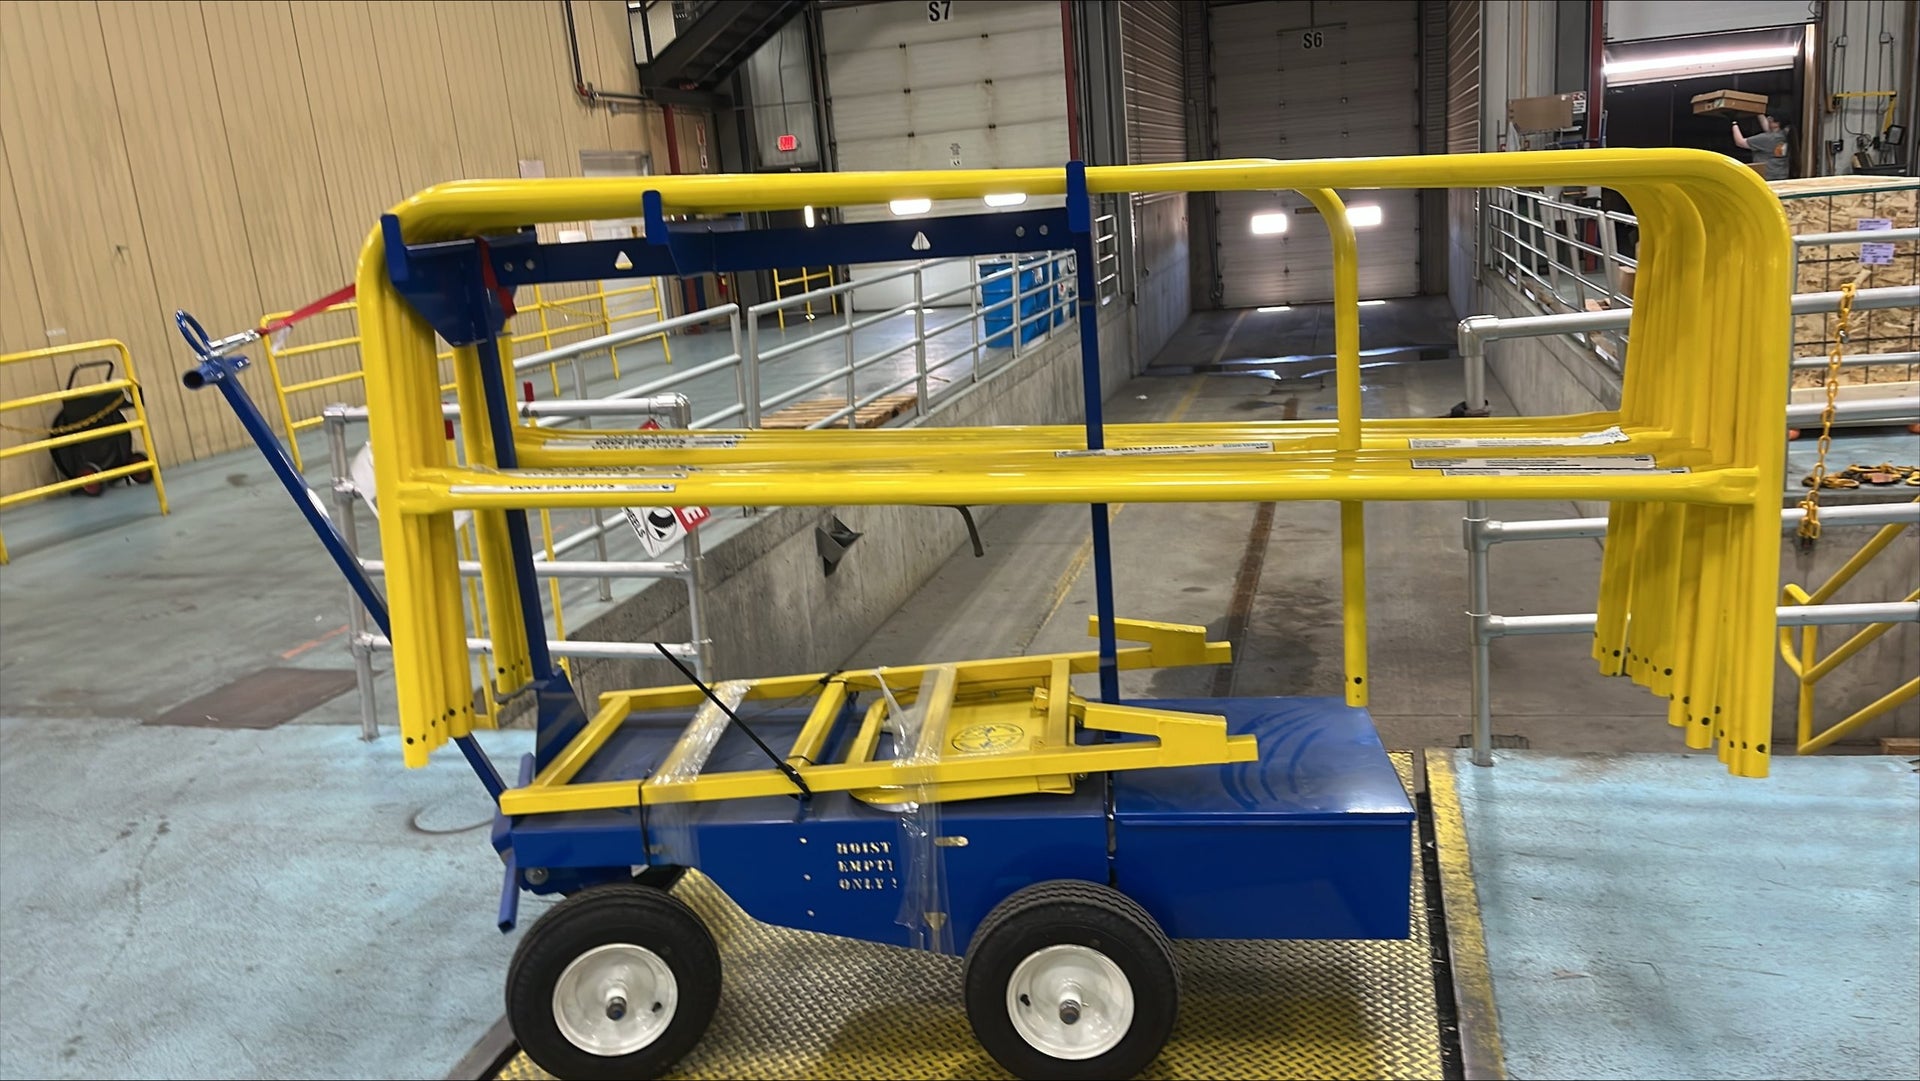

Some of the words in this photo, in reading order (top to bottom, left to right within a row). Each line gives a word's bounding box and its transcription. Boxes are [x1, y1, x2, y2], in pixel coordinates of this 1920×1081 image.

[929, 1, 951, 21] S7
[1303, 32, 1323, 49] S6
[836, 842, 892, 854] HOIST
[839, 878, 884, 890] ONLY
